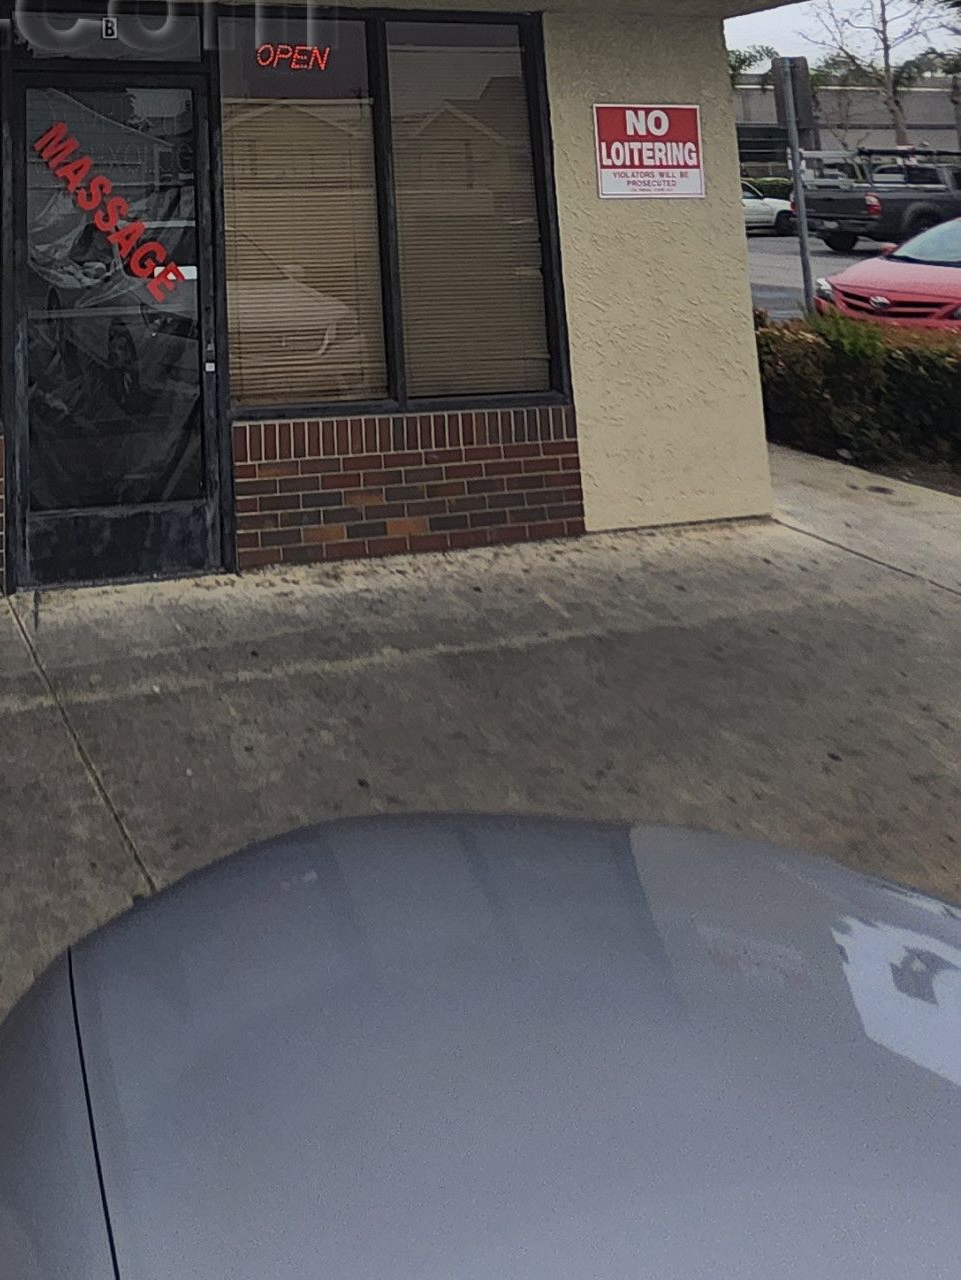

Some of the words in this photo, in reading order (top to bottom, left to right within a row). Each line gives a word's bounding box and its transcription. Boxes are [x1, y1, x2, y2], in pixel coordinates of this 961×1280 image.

[104, 19, 115, 37] B
[257, 44, 330, 70] OPEN
[625, 109, 670, 137] NO
[600, 141, 698, 166] LOITERING
[613, 171, 655, 179] VIOLATORS
[659, 171, 676, 179] WILL
[33, 121, 186, 303] MASSAGE
